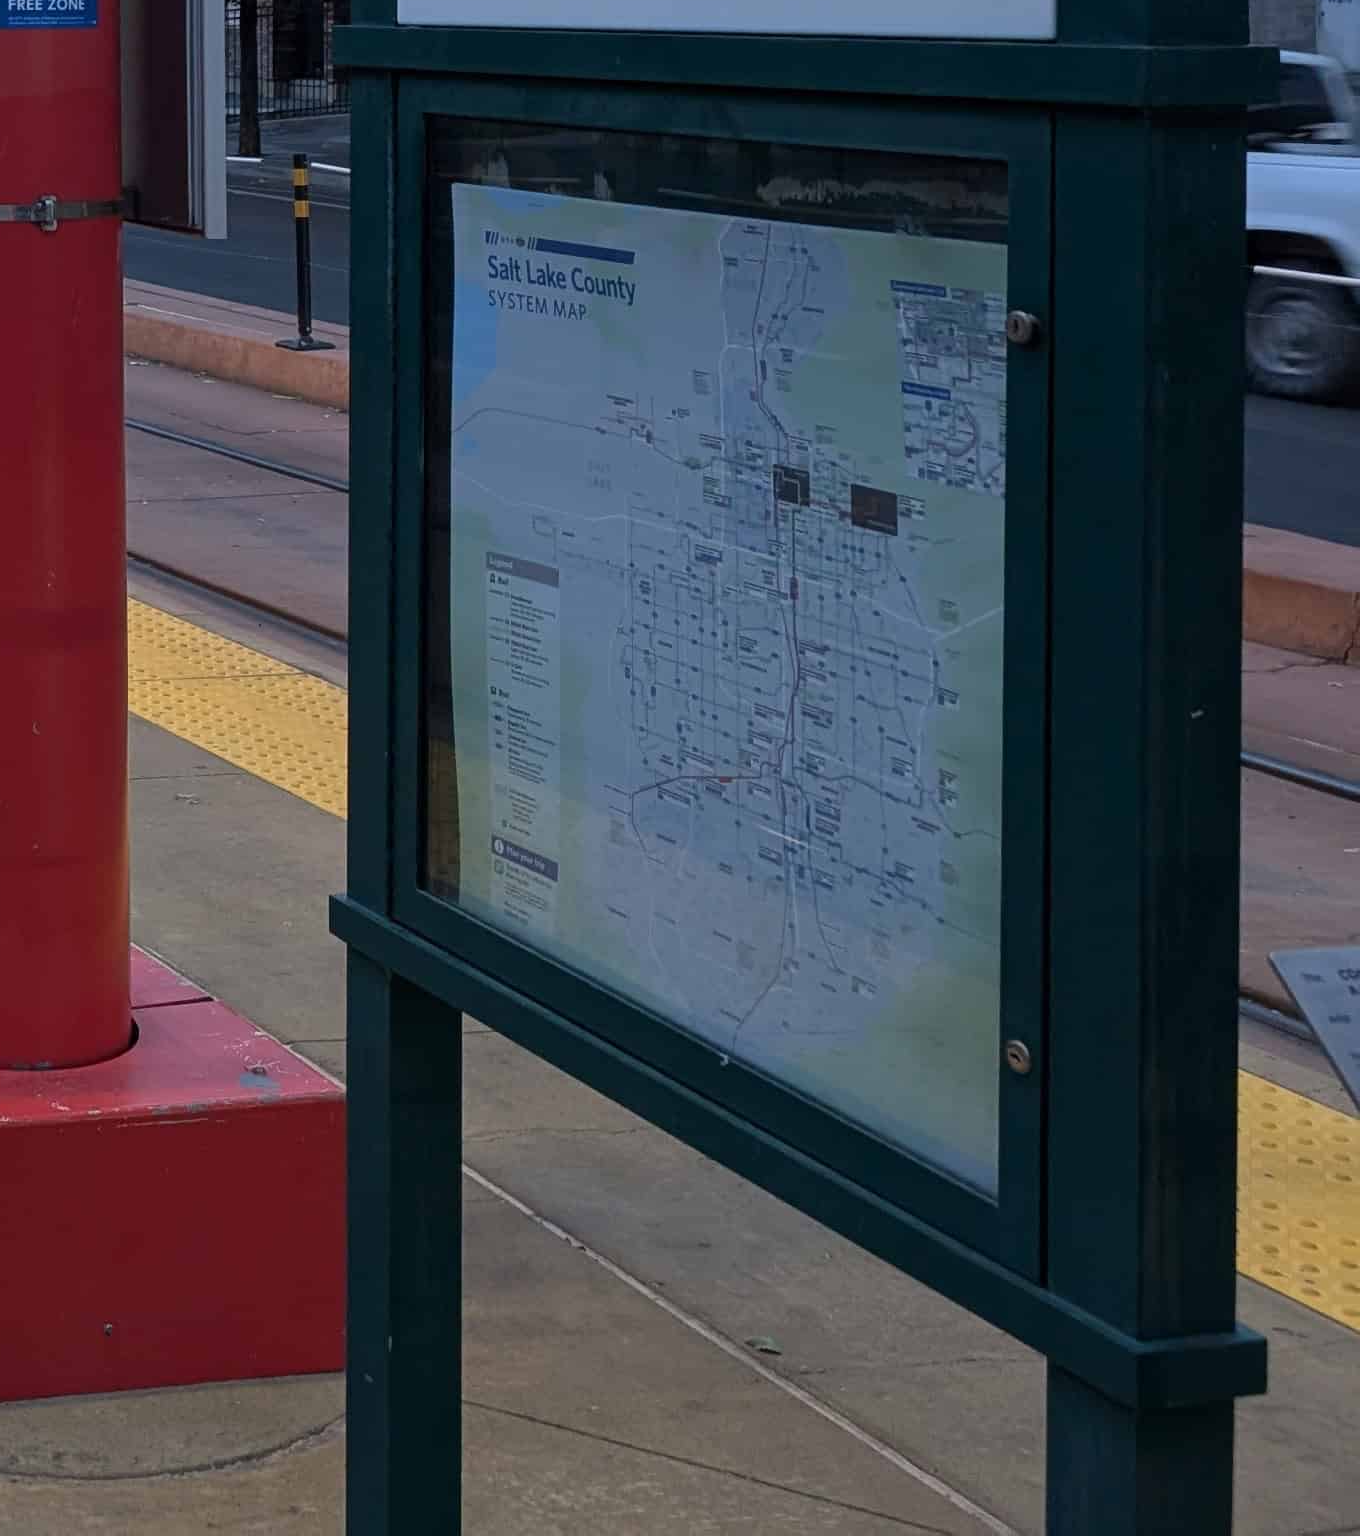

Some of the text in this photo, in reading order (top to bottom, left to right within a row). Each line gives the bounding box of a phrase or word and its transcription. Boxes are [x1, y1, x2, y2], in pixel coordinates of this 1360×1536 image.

[488, 255, 636, 306] Salt Lake County
[489, 290, 587, 320] SYSTEM MAP
